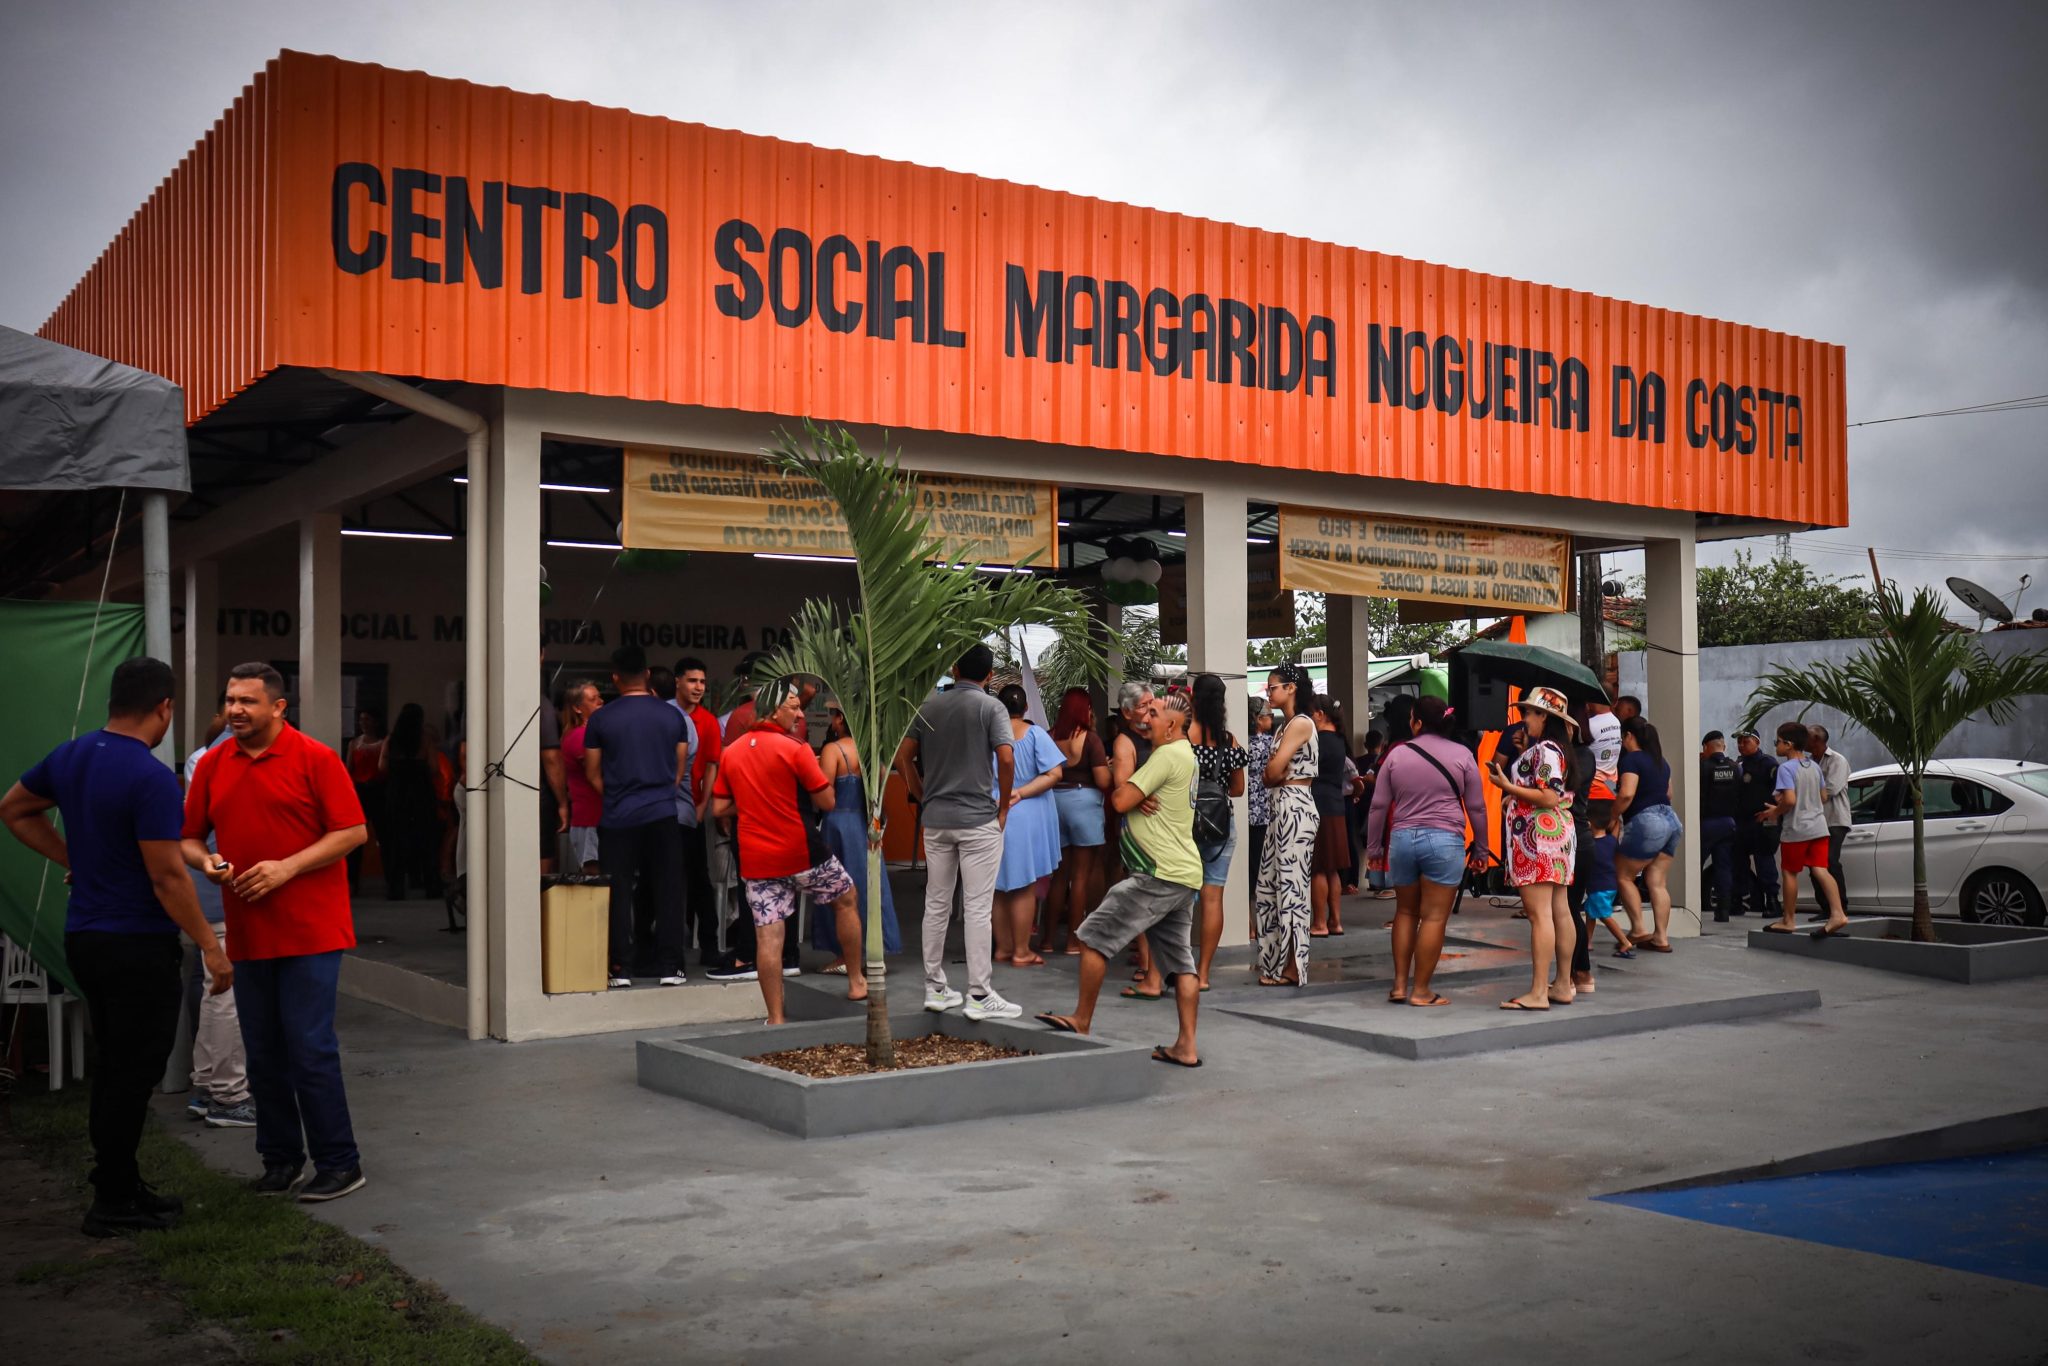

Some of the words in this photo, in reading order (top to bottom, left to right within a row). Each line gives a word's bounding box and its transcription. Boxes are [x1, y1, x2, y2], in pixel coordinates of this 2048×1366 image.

[331, 162, 669, 310] CENTRO
[714, 218, 966, 348] SOCIAL
[1005, 261, 1336, 398] MARGARIDA
[1368, 323, 1590, 432] NOGUEIRA
[1612, 365, 1666, 443] DA
[1686, 378, 1803, 463] COSTA
[620, 621, 747, 650] NOGUEIRA
